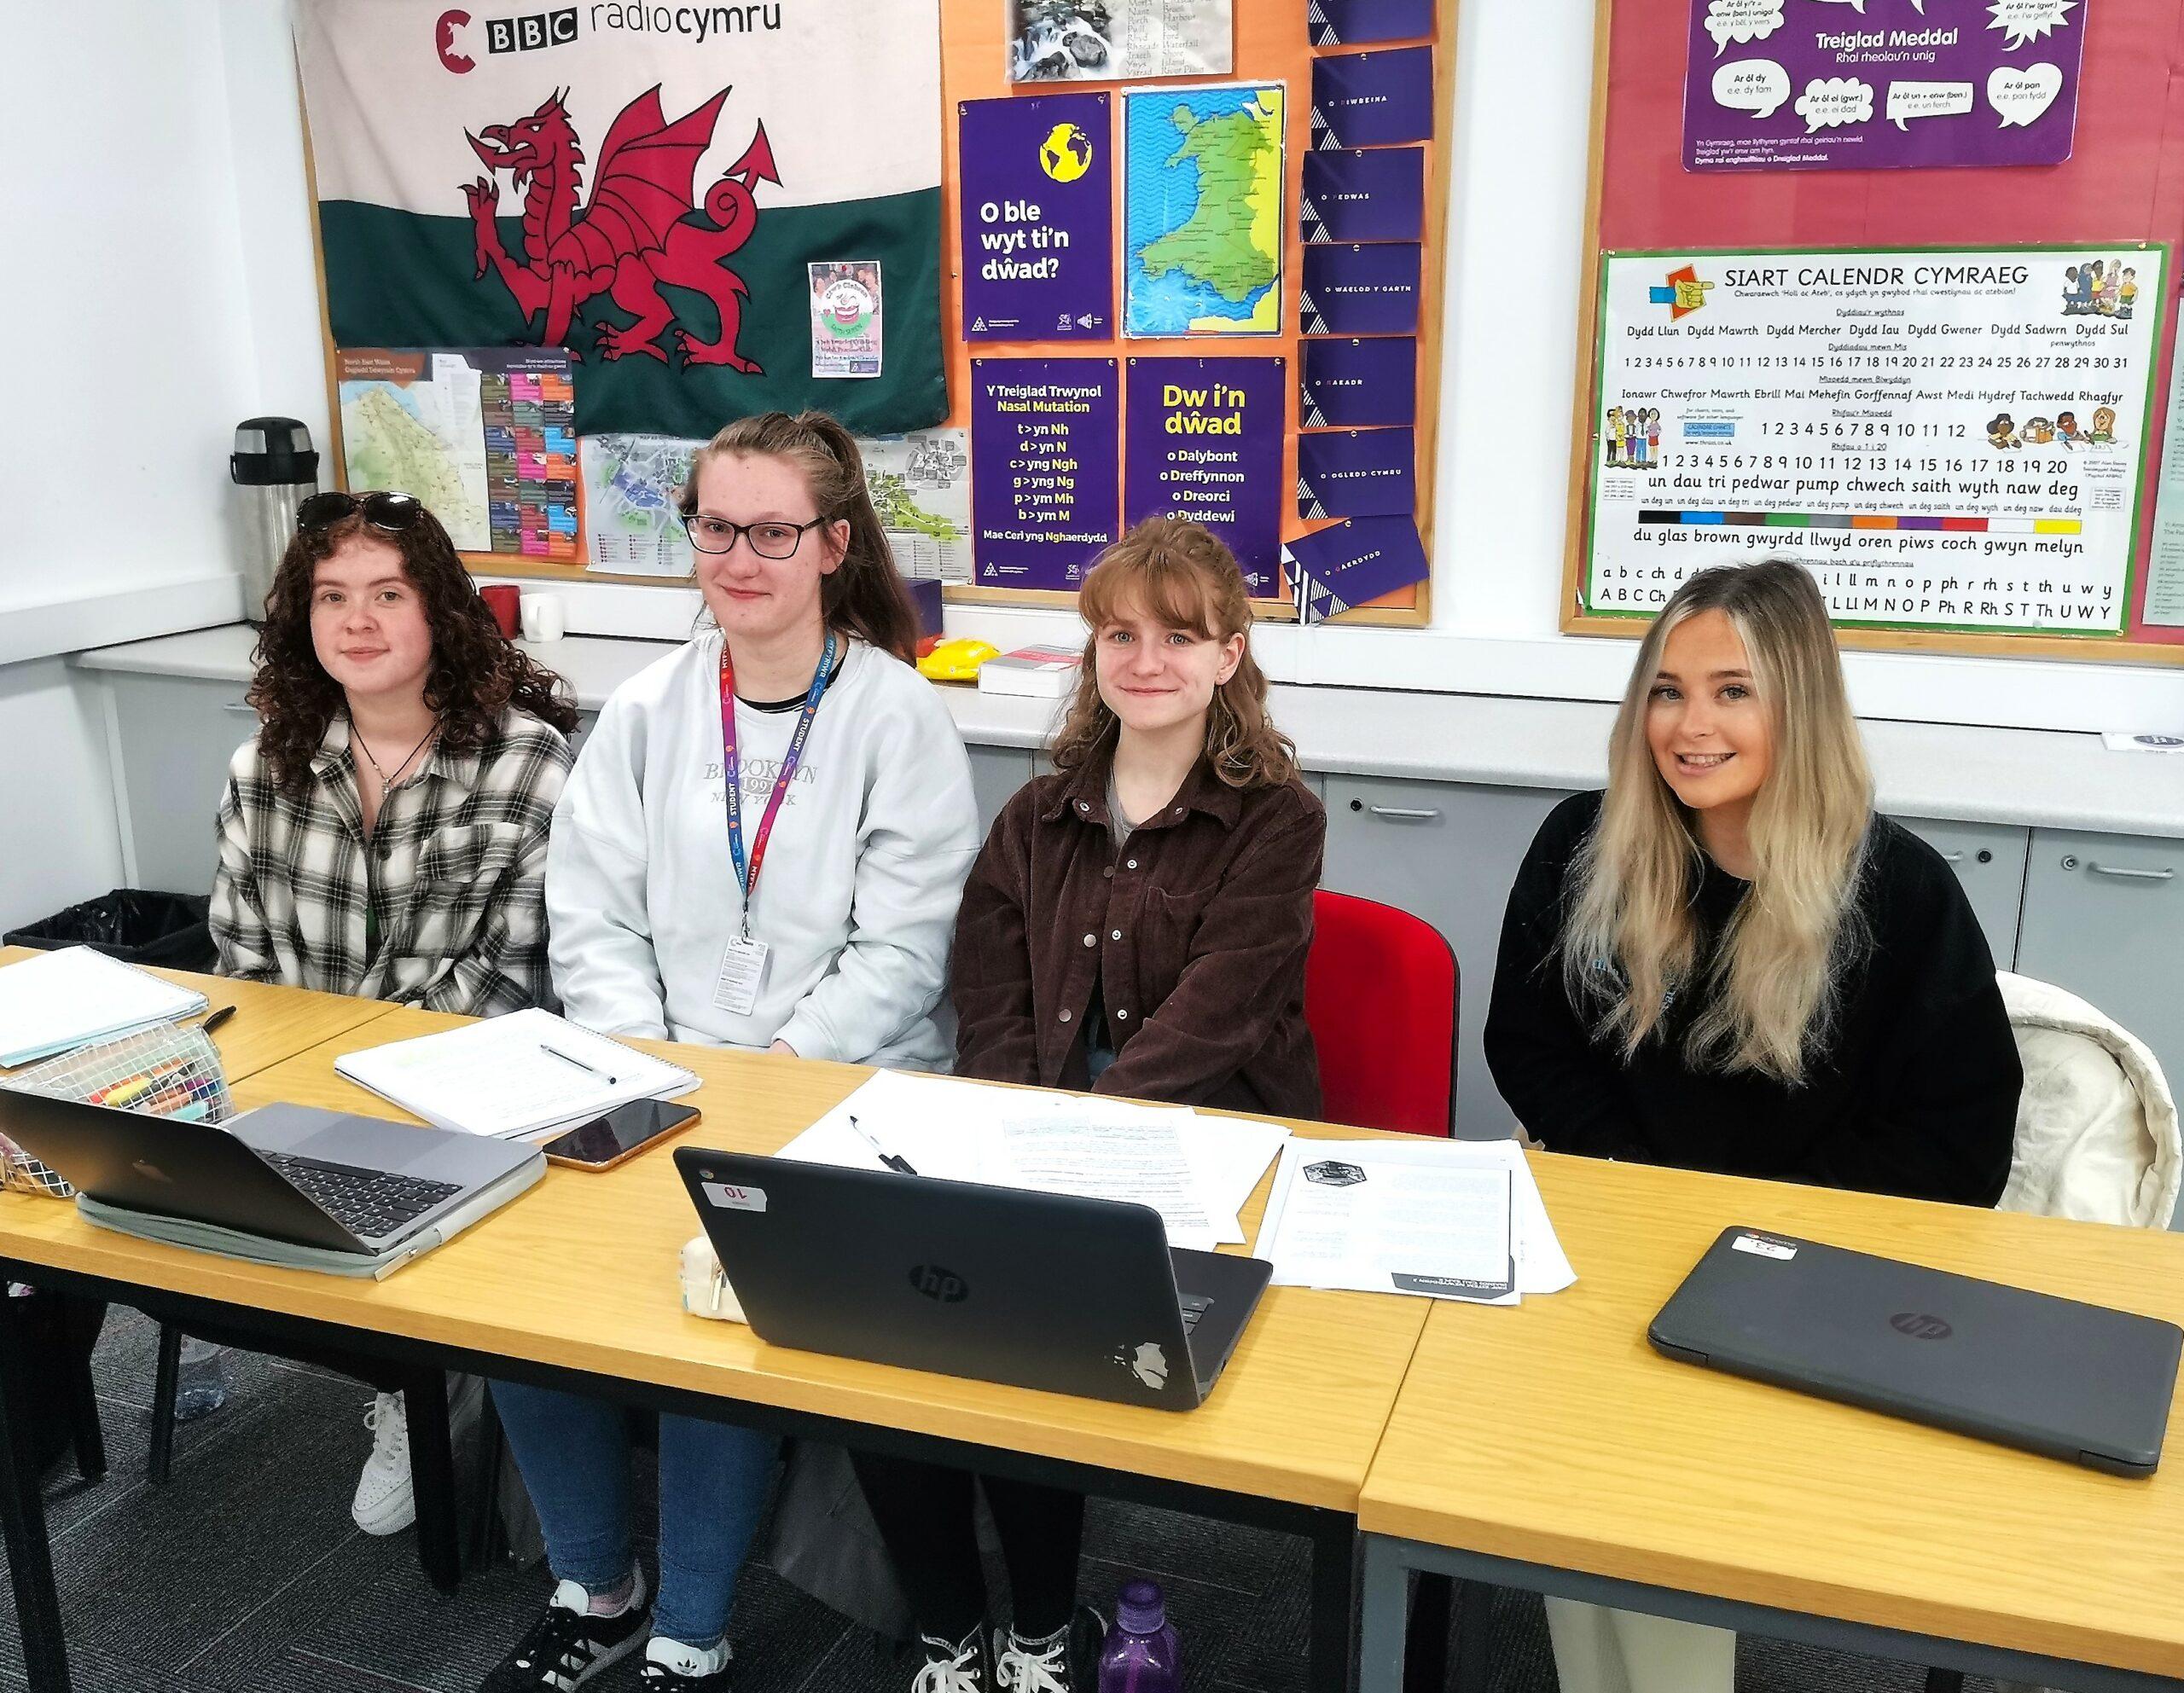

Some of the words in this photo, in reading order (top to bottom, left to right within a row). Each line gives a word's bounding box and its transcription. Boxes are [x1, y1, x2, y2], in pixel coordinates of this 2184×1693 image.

[488, 9, 578, 53] BBC
[1815, 30, 1885, 52] Treiglad
[1889, 27, 1958, 47] Meddal
[1913, 49, 1936, 63] unig
[1734, 74, 1744, 83] Ar
[1756, 73, 1767, 84] dy
[1744, 85, 1754, 96] dy
[980, 202, 999, 223] O
[1004, 200, 1041, 223] ble
[980, 229, 1026, 254] wyt
[1031, 225, 1069, 249] ti'n
[982, 257, 1059, 280] dŵad?
[1725, 269, 1789, 287] SIART
[1798, 268, 1903, 286] CALENDR
[1914, 266, 2029, 285] CYMRAEG
[1627, 326, 1654, 340] Dydd
[1658, 326, 1679, 336] Llun
[1687, 326, 1715, 339] Dydd
[1719, 325, 1759, 335] Mawrth
[1767, 325, 1794, 339] Dydd
[1798, 324, 1841, 335] Mercher
[1850, 324, 1878, 339] Dydd
[1882, 324, 1899, 335] Iau
[1908, 324, 1937, 339] Dydd
[1941, 323, 1983, 335] Gwener
[1991, 323, 2020, 339] Dydd
[2024, 323, 2066, 334] Sadwrn
[2076, 323, 2106, 339] Dydd
[2111, 323, 2128, 335] Sul
[986, 385, 996, 397] Y
[996, 384, 1047, 399] Treiglad
[1048, 385, 1101, 400] Trwynol
[1164, 385, 1207, 407] Dw
[1214, 383, 1245, 408] i'n
[1622, 389, 1657, 398] Ionawr
[1661, 389, 1707, 402] Chwefror
[1711, 389, 1751, 398] Mawrth
[1755, 389, 1780, 399] Ebrill
[1785, 389, 1804, 399] Mai
[1809, 389, 1850, 403] Mehefin
[1855, 389, 1913, 403] Gorffennaf
[1915, 390, 1943, 399] Awst
[1948, 390, 1973, 400] Medi
[1978, 390, 2016, 403] Hydref
[2020, 391, 2074, 401] Tachwedd
[2079, 391, 2123, 405] Rhagfyr
[997, 400, 1031, 412] Nasal
[1033, 400, 1089, 413] Mutation
[1051, 423, 1069, 435] Nh
[1165, 410, 1241, 435] dŵad
[1762, 422, 1767, 435] 1
[1774, 422, 1784, 435] 2
[1790, 422, 1798, 436] 3
[1804, 422, 1814, 435] 4
[1820, 422, 1828, 436] 5
[1835, 423, 1844, 436] 6
[1850, 423, 1859, 436] 7
[1865, 423, 1873, 437] 8
[1880, 423, 1889, 436] 9
[1897, 424, 1914, 437] 10
[1923, 424, 1937, 437] 11
[1949, 424, 1965, 438] 12
[1057, 441, 1066, 453] N
[1167, 452, 1176, 461] o
[1178, 449, 1238, 464] Dalybont
[1052, 458, 1077, 473] Ngh
[1057, 476, 1074, 490] Ng
[1159, 472, 1168, 481] o
[1170, 469, 1245, 484] Dreffynnon
[1648, 478, 1667, 488] un
[1674, 473, 1702, 488] dau
[1709, 475, 1726, 488] tri
[1732, 474, 1790, 494] pedwar
[1796, 479, 1839, 496] pump
[1847, 477, 1905, 492] chwech
[1911, 478, 1951, 493] saith
[1959, 479, 1999, 499] wyth
[2007, 484, 2042, 495] naw
[2048, 481, 2078, 502] deg
[1054, 492, 1074, 504] Mh
[1172, 492, 1182, 502] o
[1183, 490, 1230, 502] Dreorci
[1059, 510, 1070, 521] M
[1167, 512, 1175, 520] o
[984, 530, 1003, 539] Mae
[1004, 530, 1024, 540] Ceri
[1025, 533, 1044, 542] yng
[1045, 531, 1107, 544] Nghaerdydd
[1634, 528, 1652, 541] du
[1658, 528, 1687, 546] glas
[1694, 529, 1740, 543] brown
[1747, 531, 1803, 549] gwyrdd
[1810, 531, 1851, 552] llwyd
[1858, 537, 1892, 548] oren
[1899, 536, 1934, 553] piws
[1942, 536, 1977, 550] coch
[1984, 541, 2027, 556] gwyn
[2035, 538, 2083, 559] melyn
[793, 717, 810, 751] STUDENT
[729, 782, 738, 816] STUDENT
